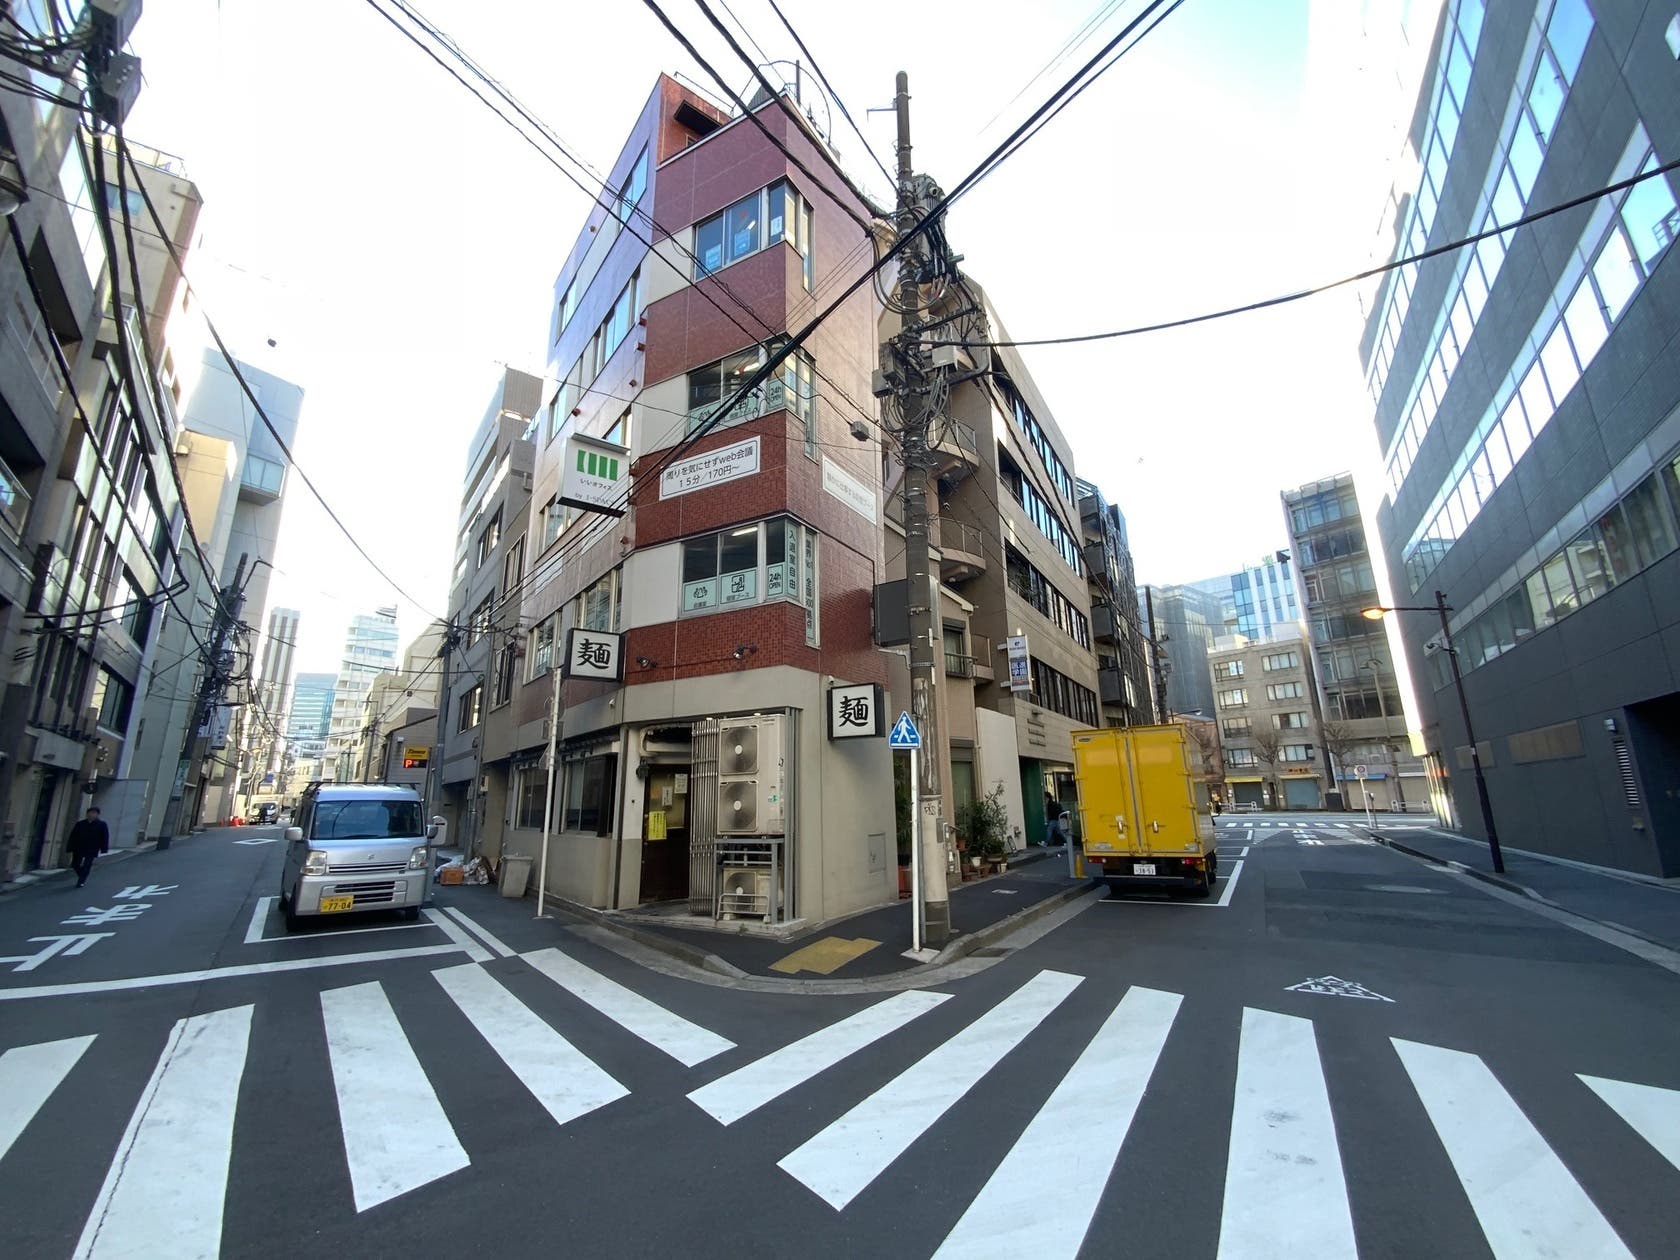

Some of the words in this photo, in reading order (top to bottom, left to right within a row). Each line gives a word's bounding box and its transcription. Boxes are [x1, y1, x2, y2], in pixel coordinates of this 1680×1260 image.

[665, 446, 753, 480] 周りを気にせずweb会議
[769, 573, 782, 582] 24h
[769, 582, 782, 590] OPEN
[577, 638, 611, 670] 麺
[839, 696, 868, 727] 麺
[405, 759, 413, 768] P
